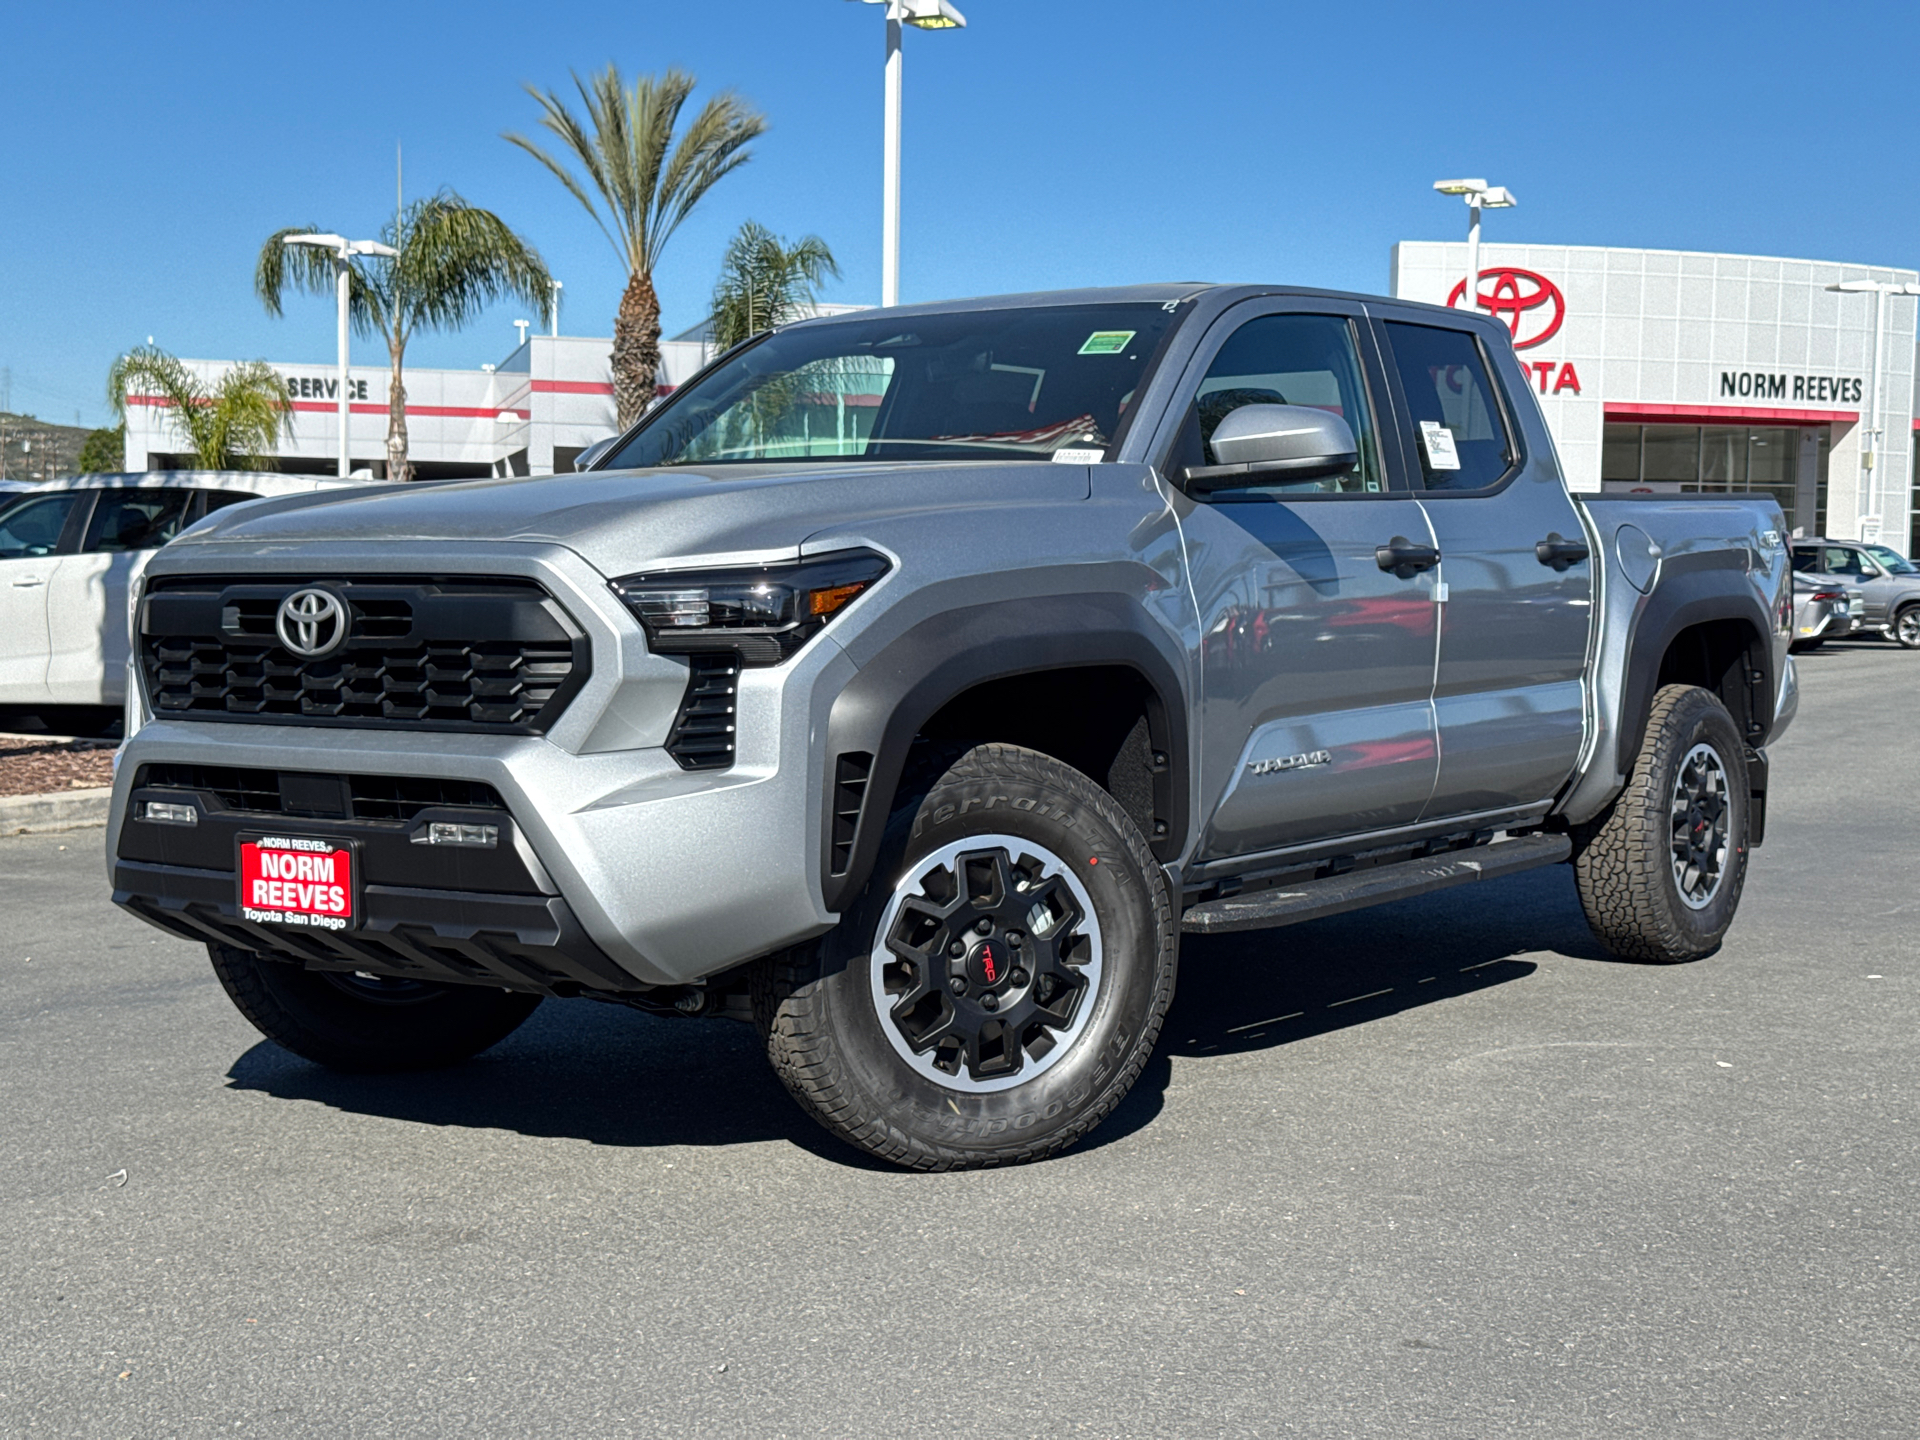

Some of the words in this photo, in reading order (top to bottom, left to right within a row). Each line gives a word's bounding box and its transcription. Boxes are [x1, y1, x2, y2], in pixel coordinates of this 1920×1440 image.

[287, 377, 368, 400] SERVCE
[1720, 371, 1787, 399] NORM
[1792, 375, 1863, 403] REEVES
[1247, 749, 1331, 775] TACOMA
[911, 795, 1079, 839] Terrain
[262, 836, 291, 849] NORM
[291, 839, 326, 852] REEVES
[260, 852, 335, 883] NORM
[252, 879, 345, 912] REEVES
[242, 907, 282, 923] Toyota
[284, 911, 308, 925] San
[310, 913, 346, 930] Diego
[982, 944, 996, 982] TRD
